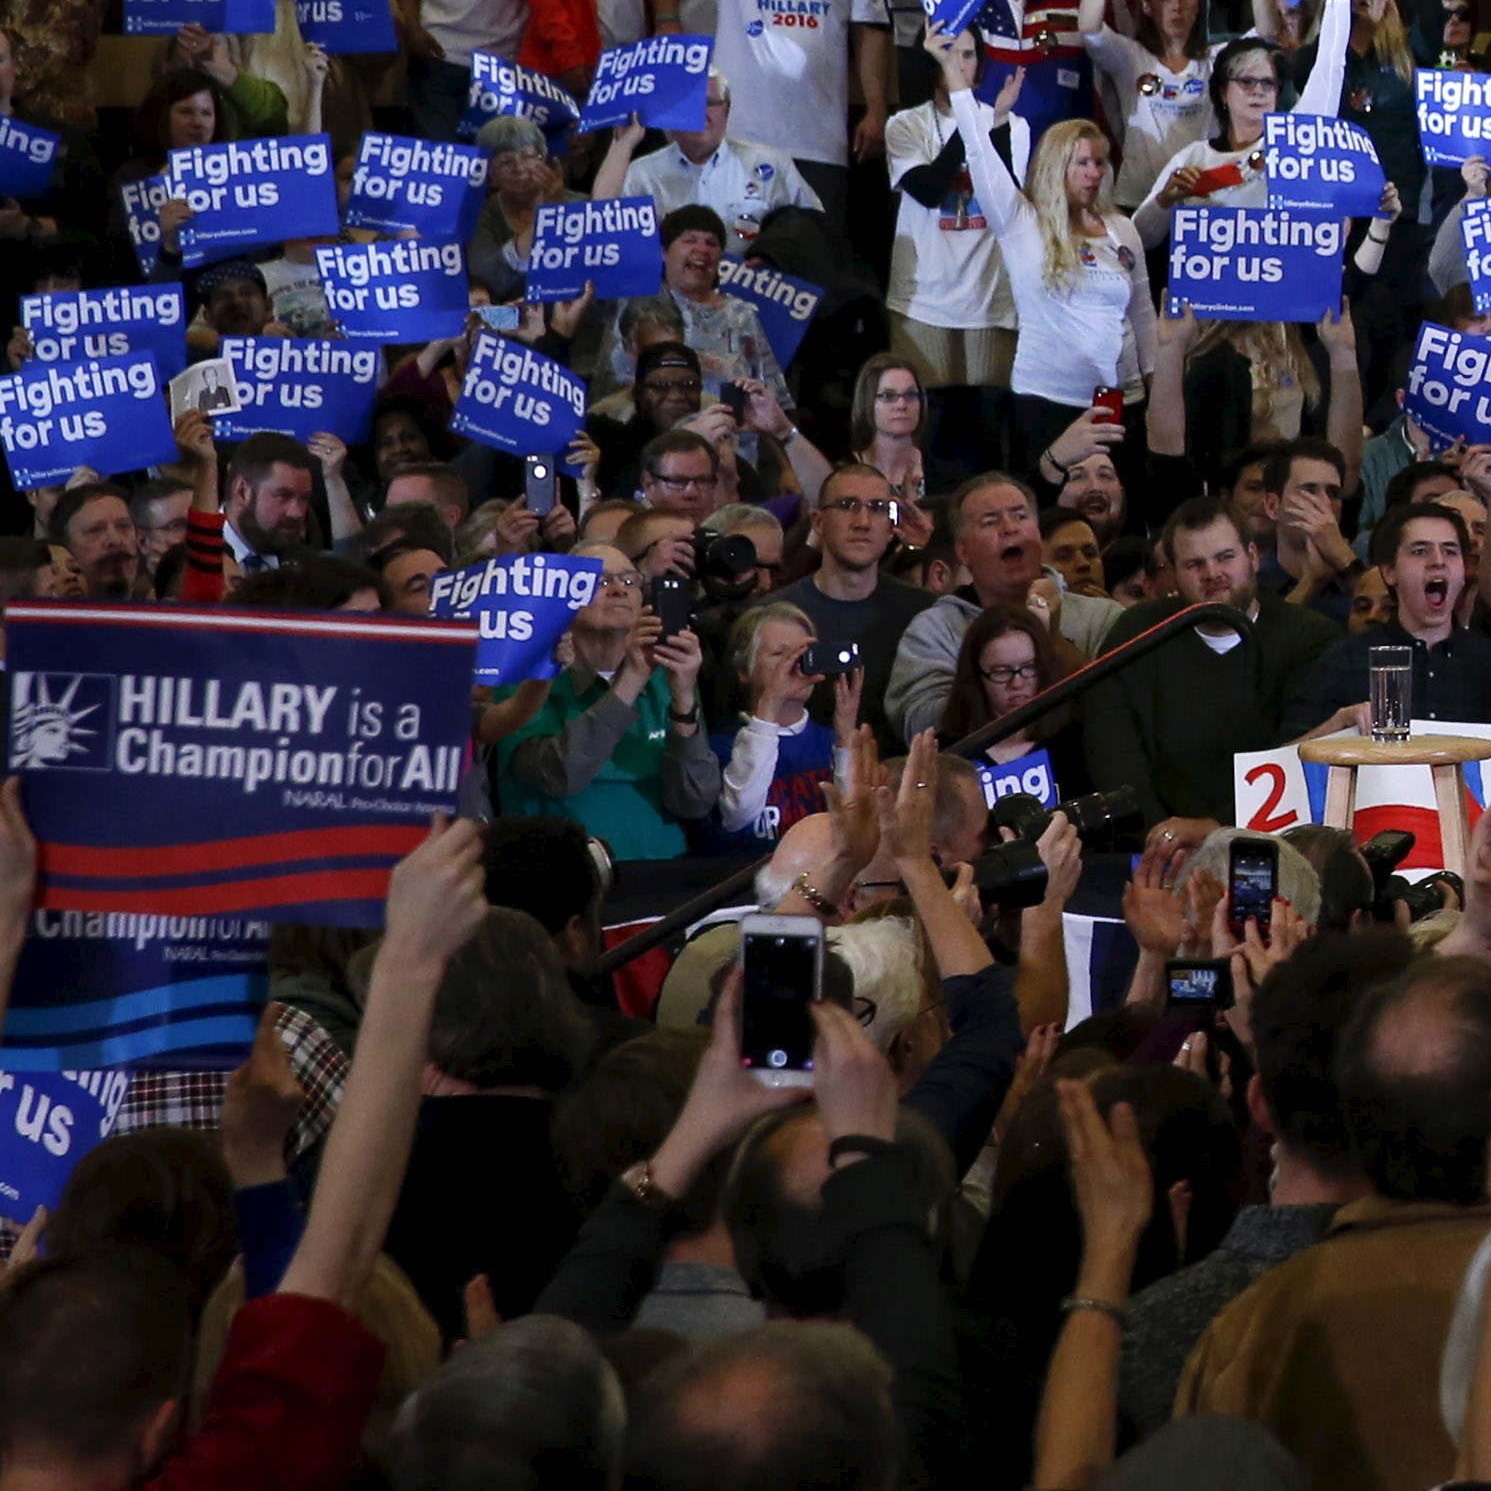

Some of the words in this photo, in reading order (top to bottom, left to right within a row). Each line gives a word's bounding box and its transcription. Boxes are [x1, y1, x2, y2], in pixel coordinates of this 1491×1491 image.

[773, 13, 818, 29] 2016
[317, 240, 461, 291] Fighting
[325, 279, 375, 310] for
[377, 284, 419, 309] us
[1409, 370, 1470, 412] for
[118, 674, 338, 735] HILLARY
[349, 687, 382, 738] is
[395, 703, 421, 739] a
